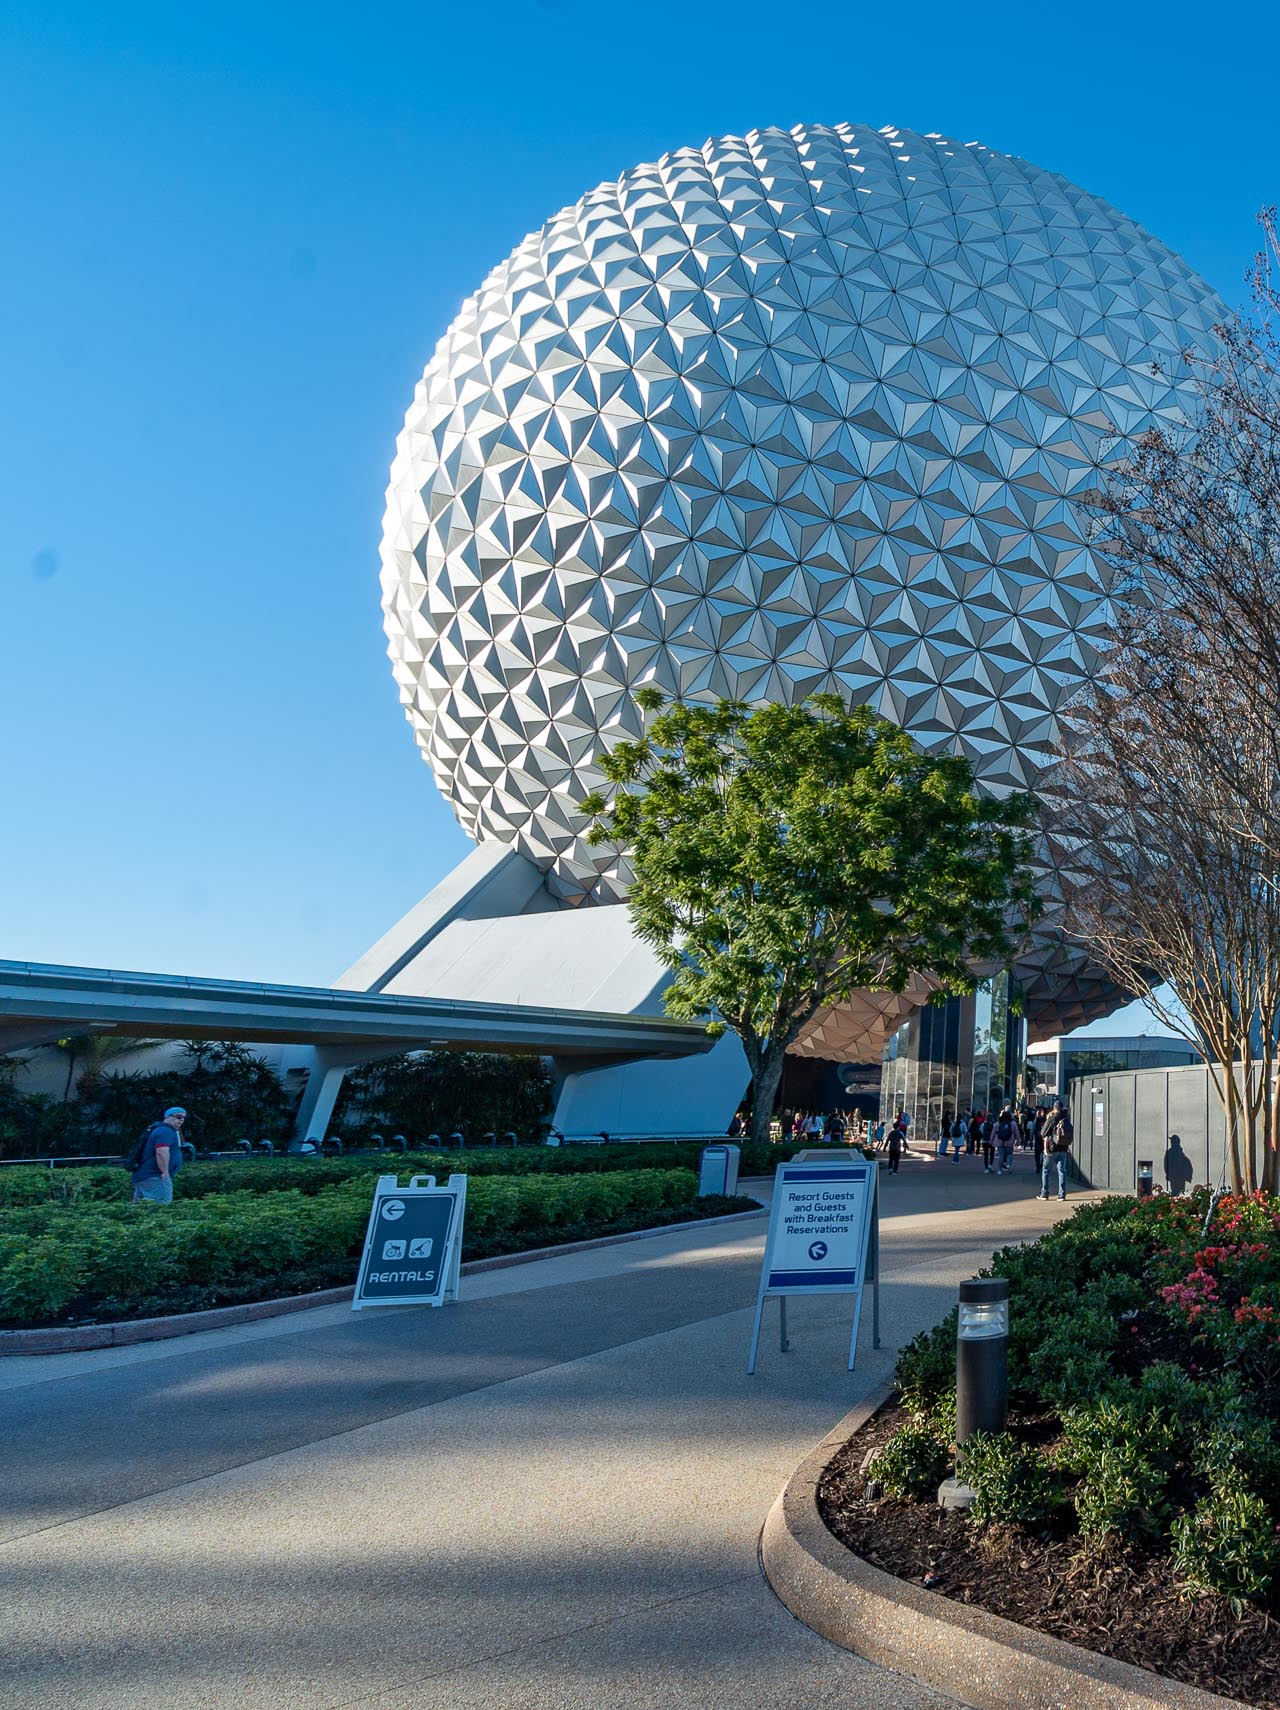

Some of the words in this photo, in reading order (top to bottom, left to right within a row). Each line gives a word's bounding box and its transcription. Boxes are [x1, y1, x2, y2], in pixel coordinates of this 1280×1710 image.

[789, 1192, 820, 1202] Resort
[822, 1191, 855, 1201] Guests
[793, 1203, 812, 1212] and
[814, 1202, 847, 1212] Guests
[784, 1214, 805, 1224] with
[807, 1213, 854, 1223] Breakfast
[786, 1225, 849, 1235] Reservations
[369, 1271, 435, 1283] RENTALS
